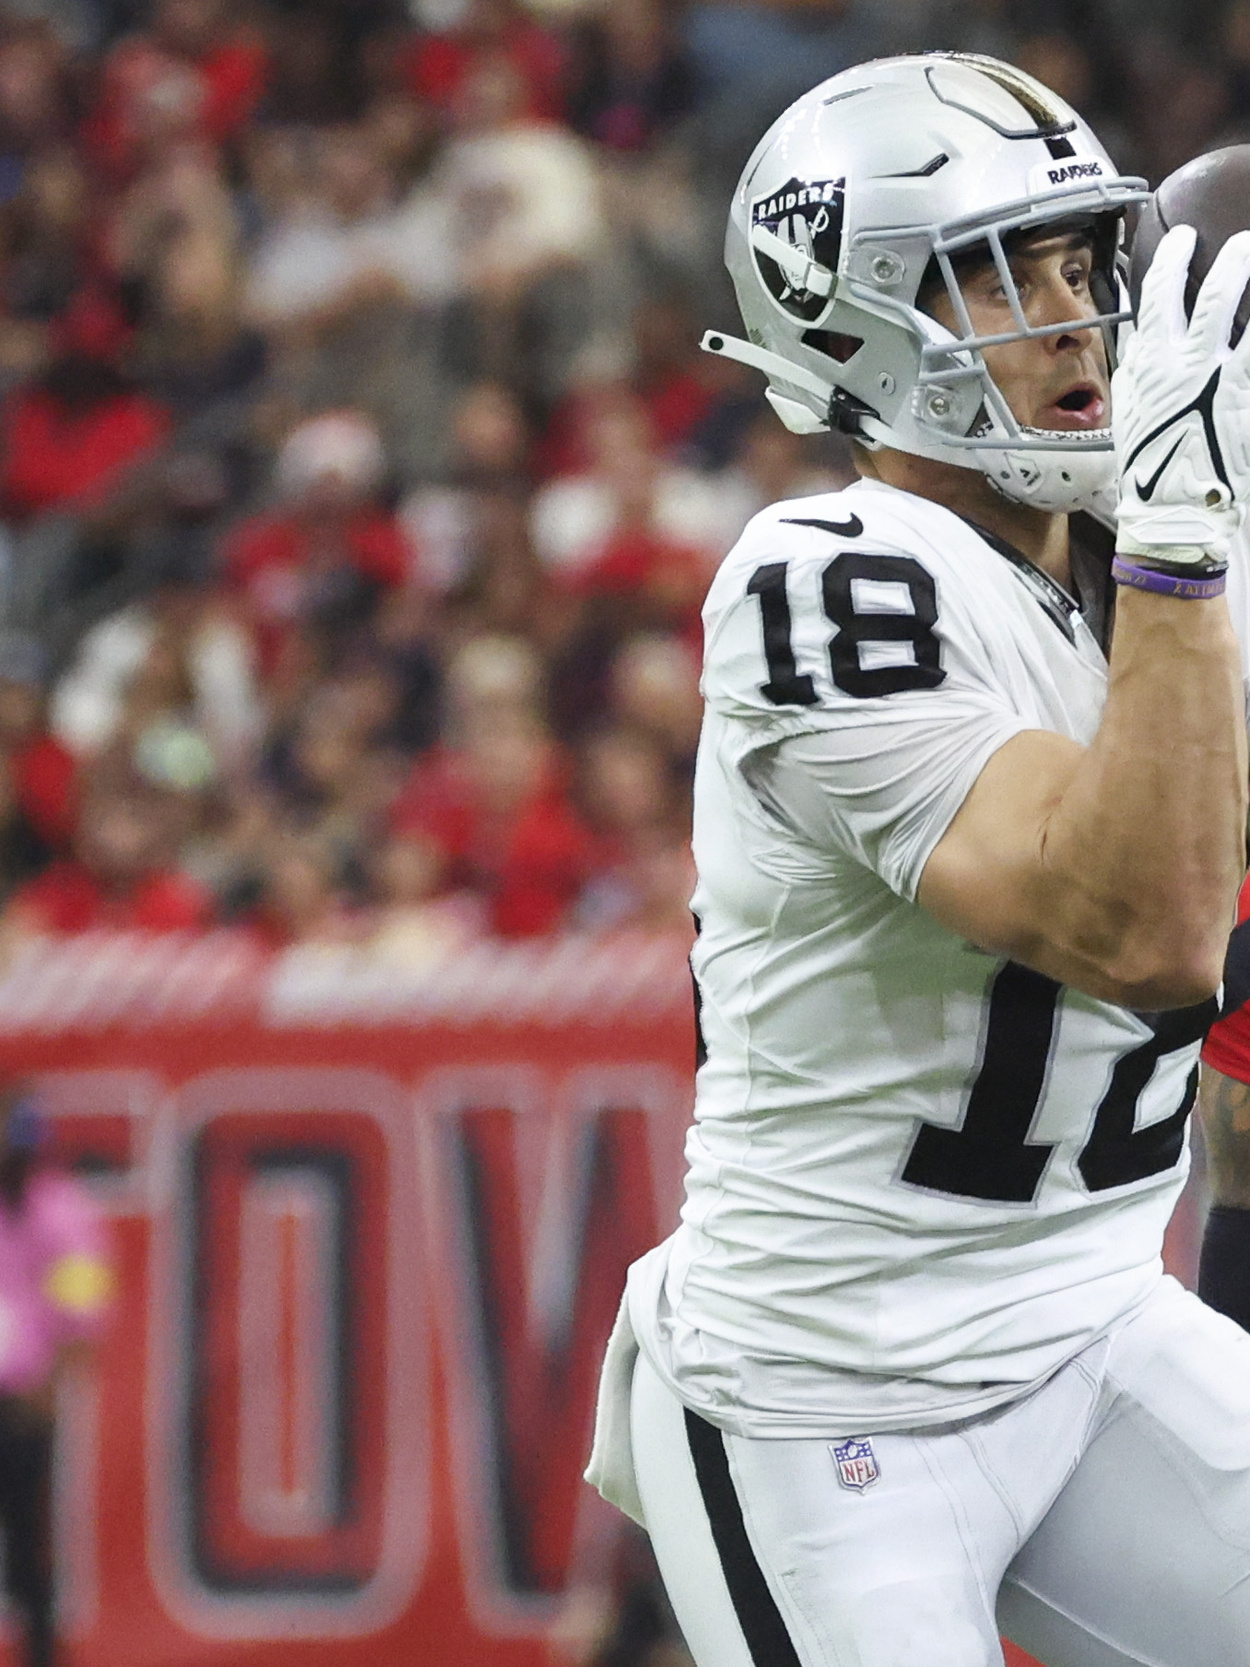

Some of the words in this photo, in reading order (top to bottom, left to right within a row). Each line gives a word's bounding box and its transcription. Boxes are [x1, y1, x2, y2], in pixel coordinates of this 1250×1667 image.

[1047, 162, 1102, 185] RAIDERS
[757, 183, 837, 221] RAIDERS
[747, 552, 947, 706] 18
[842, 1460, 875, 1483] NFL
